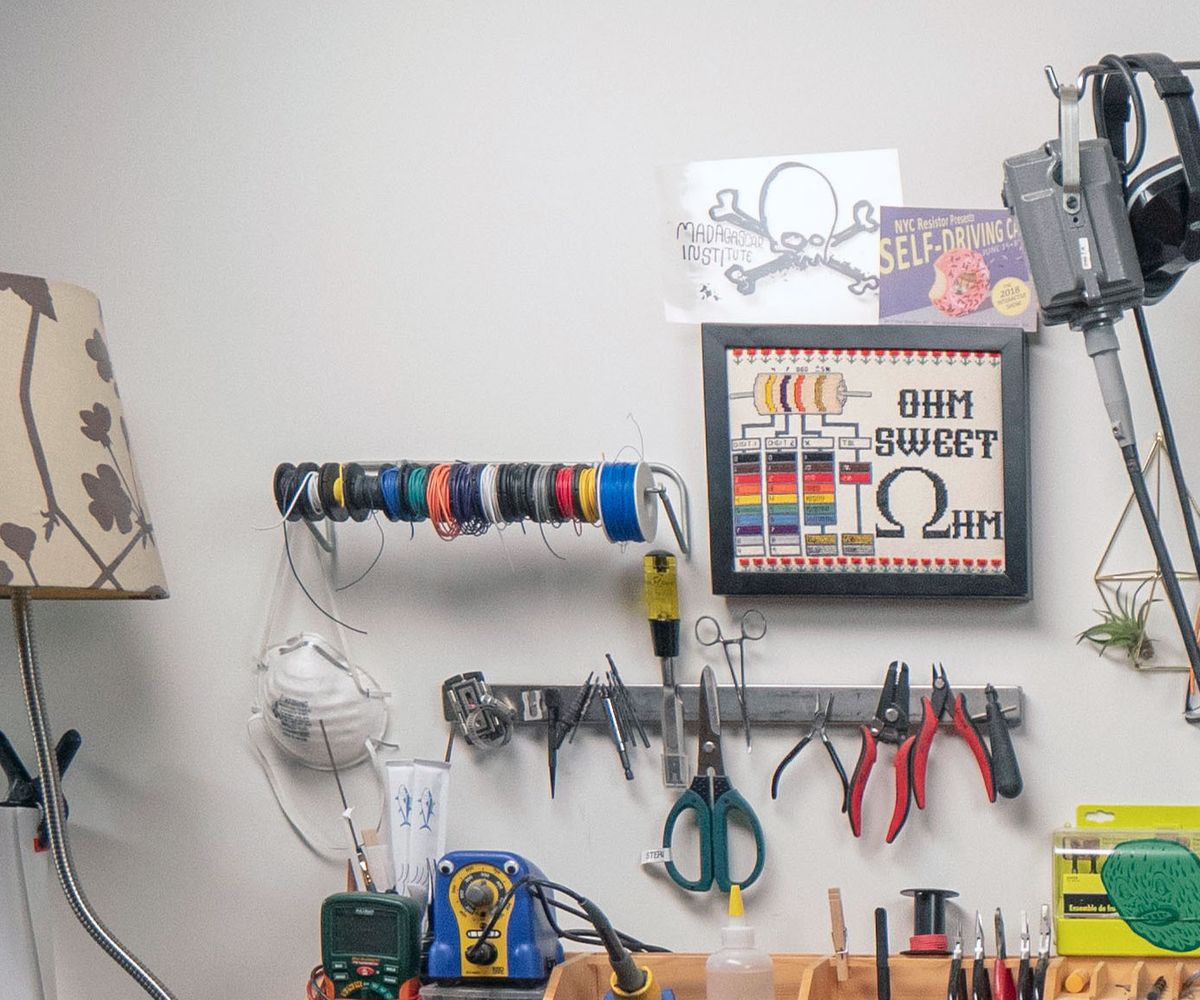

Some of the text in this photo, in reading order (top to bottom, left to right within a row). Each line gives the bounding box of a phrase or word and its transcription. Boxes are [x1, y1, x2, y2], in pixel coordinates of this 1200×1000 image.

[894, 218, 916, 234] NYC
[917, 215, 949, 230] Resistor
[681, 243, 753, 267] INSTITUTE
[879, 218, 1004, 275] SELF-DRIVING
[1000, 286, 1020, 299] 2018
[897, 388, 974, 420] OHM
[875, 427, 999, 460] SWEET
[1068, 903, 1098, 914] Ensemble
